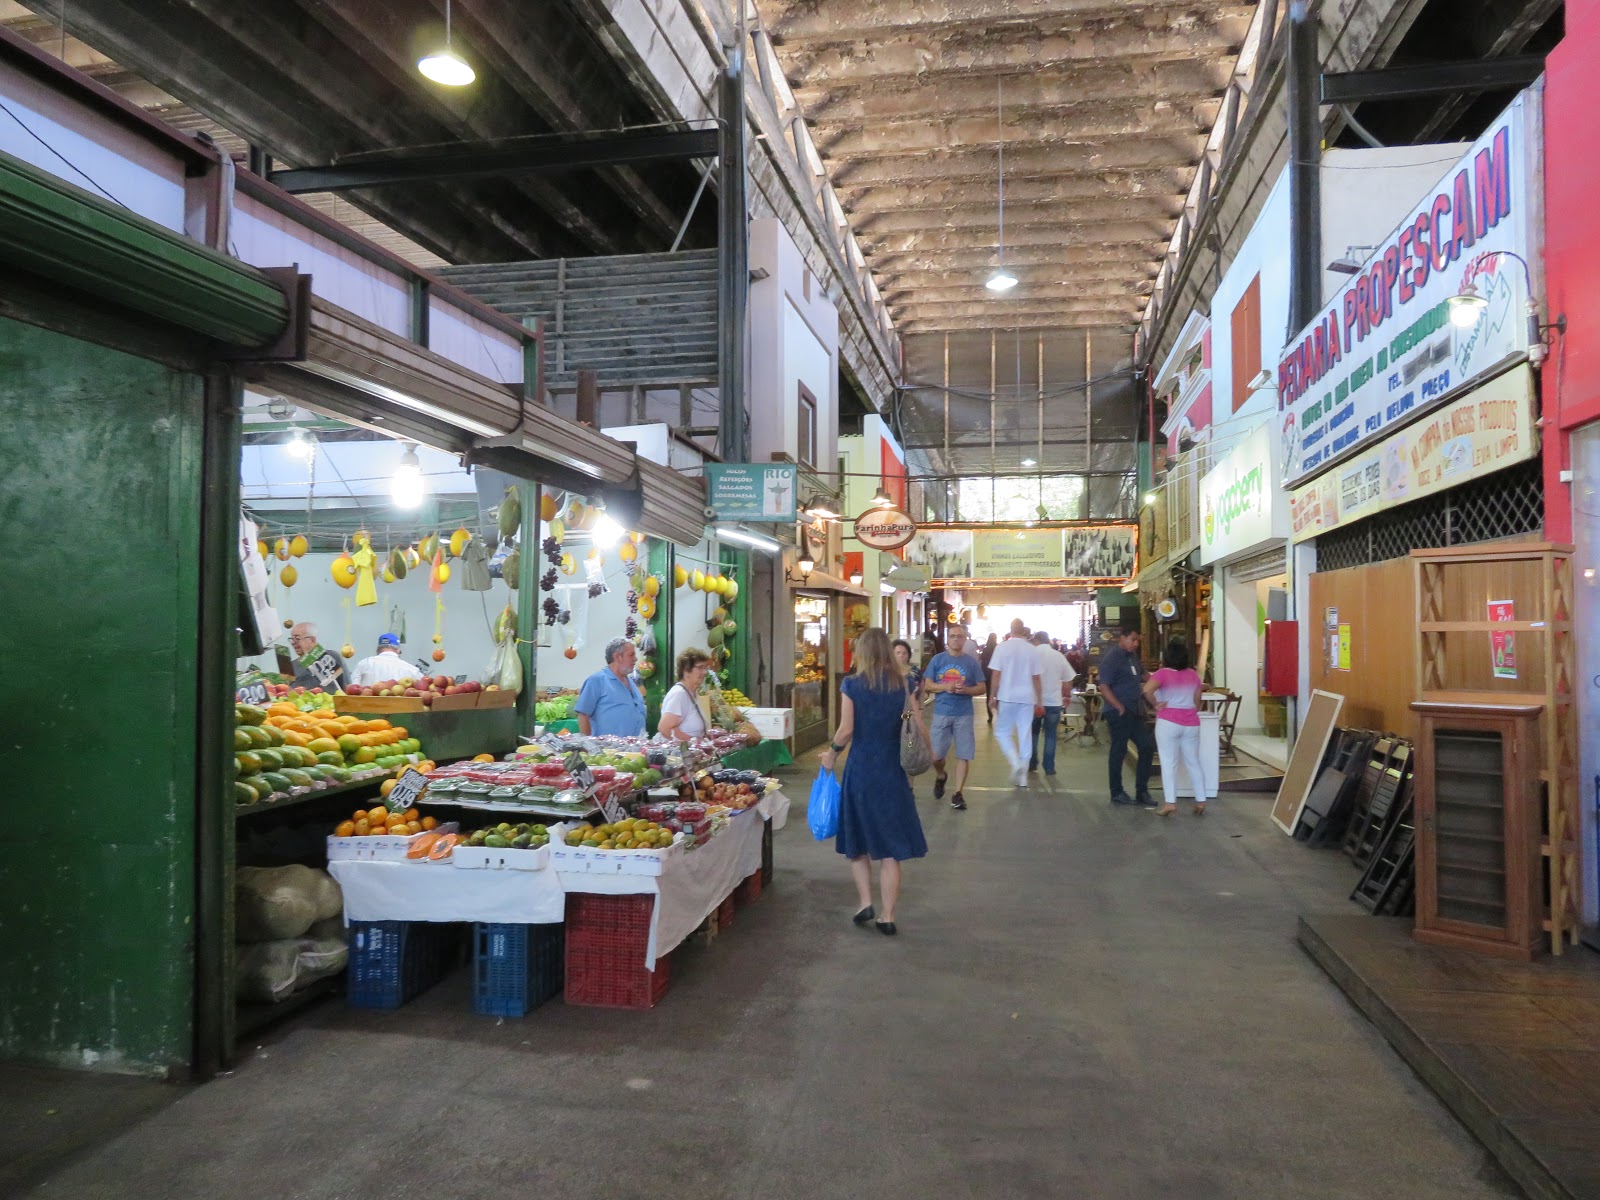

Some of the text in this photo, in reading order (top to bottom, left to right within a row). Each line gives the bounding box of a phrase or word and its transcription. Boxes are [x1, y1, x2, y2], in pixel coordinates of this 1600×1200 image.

[1278, 309, 1341, 411] PEIXARIA
[1344, 126, 1510, 353] PROPESCAM
[1421, 369, 1450, 399] PREÇO
[765, 469, 792, 479] RIO
